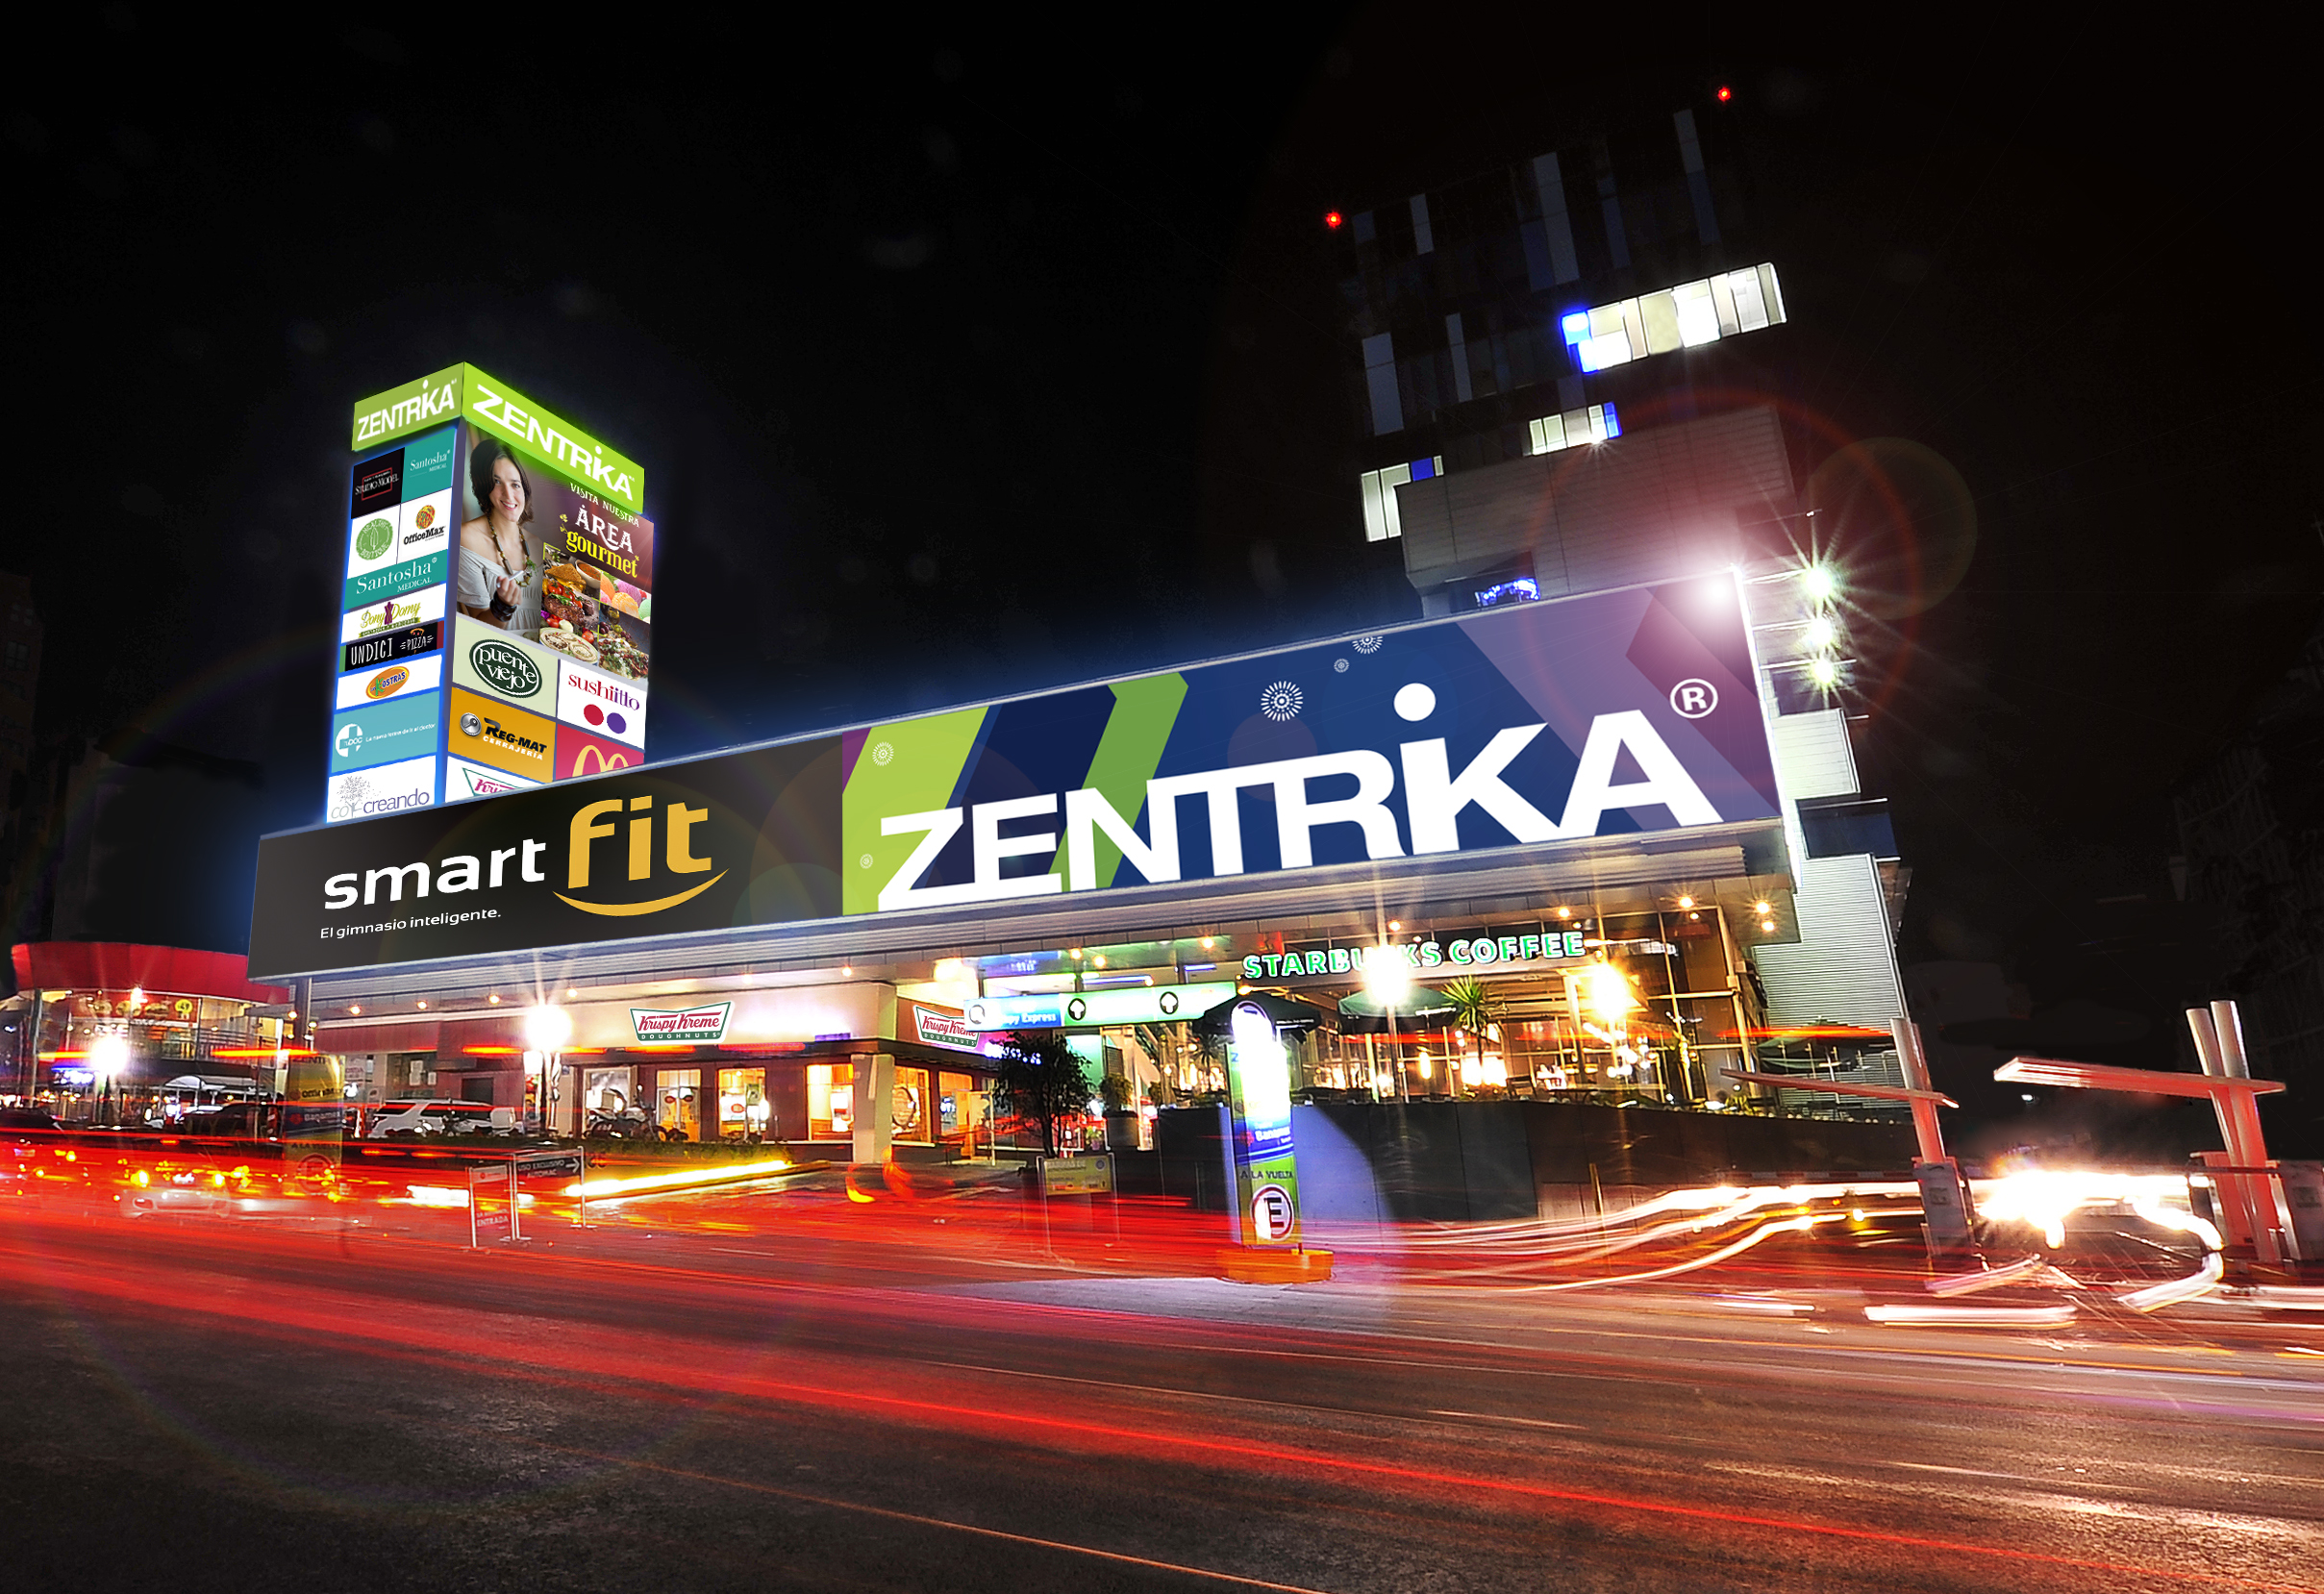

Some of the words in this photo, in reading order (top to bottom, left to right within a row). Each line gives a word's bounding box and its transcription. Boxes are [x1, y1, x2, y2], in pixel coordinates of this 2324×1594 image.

[410, 451, 447, 471] Santosha
[569, 482, 599, 505] VISITA
[602, 500, 640, 528] NUESTRA
[403, 526, 445, 545] OfficeMax
[565, 529, 637, 578] gourmet
[356, 560, 432, 594] Santosha
[397, 577, 432, 592] MEDICAL
[351, 637, 393, 665] UNDICI
[407, 635, 427, 651] PIZZA
[478, 646, 537, 685] puente
[486, 663, 526, 690] viejo
[484, 717, 547, 754] REG-MAT
[324, 838, 546, 909] smart
[567, 795, 712, 889] fit
[320, 926, 334, 939] El
[336, 917, 408, 938] gimnasio
[410, 908, 501, 929] inteligente.
[1448, 931, 1587, 965] COFFEE
[637, 1013, 679, 1033] Krispy
[677, 1010, 722, 1030] Kreme
[641, 1032, 717, 1040] DOUGHNUTS
[922, 1015, 950, 1035] Krispy
[924, 1033, 976, 1046] DOUGHNUTS
[1240, 1170, 1248, 1179] A
[1250, 1170, 1263, 1180] LA
[1265, 1169, 1293, 1180] VUELTA
[1263, 1197, 1285, 1229] E
